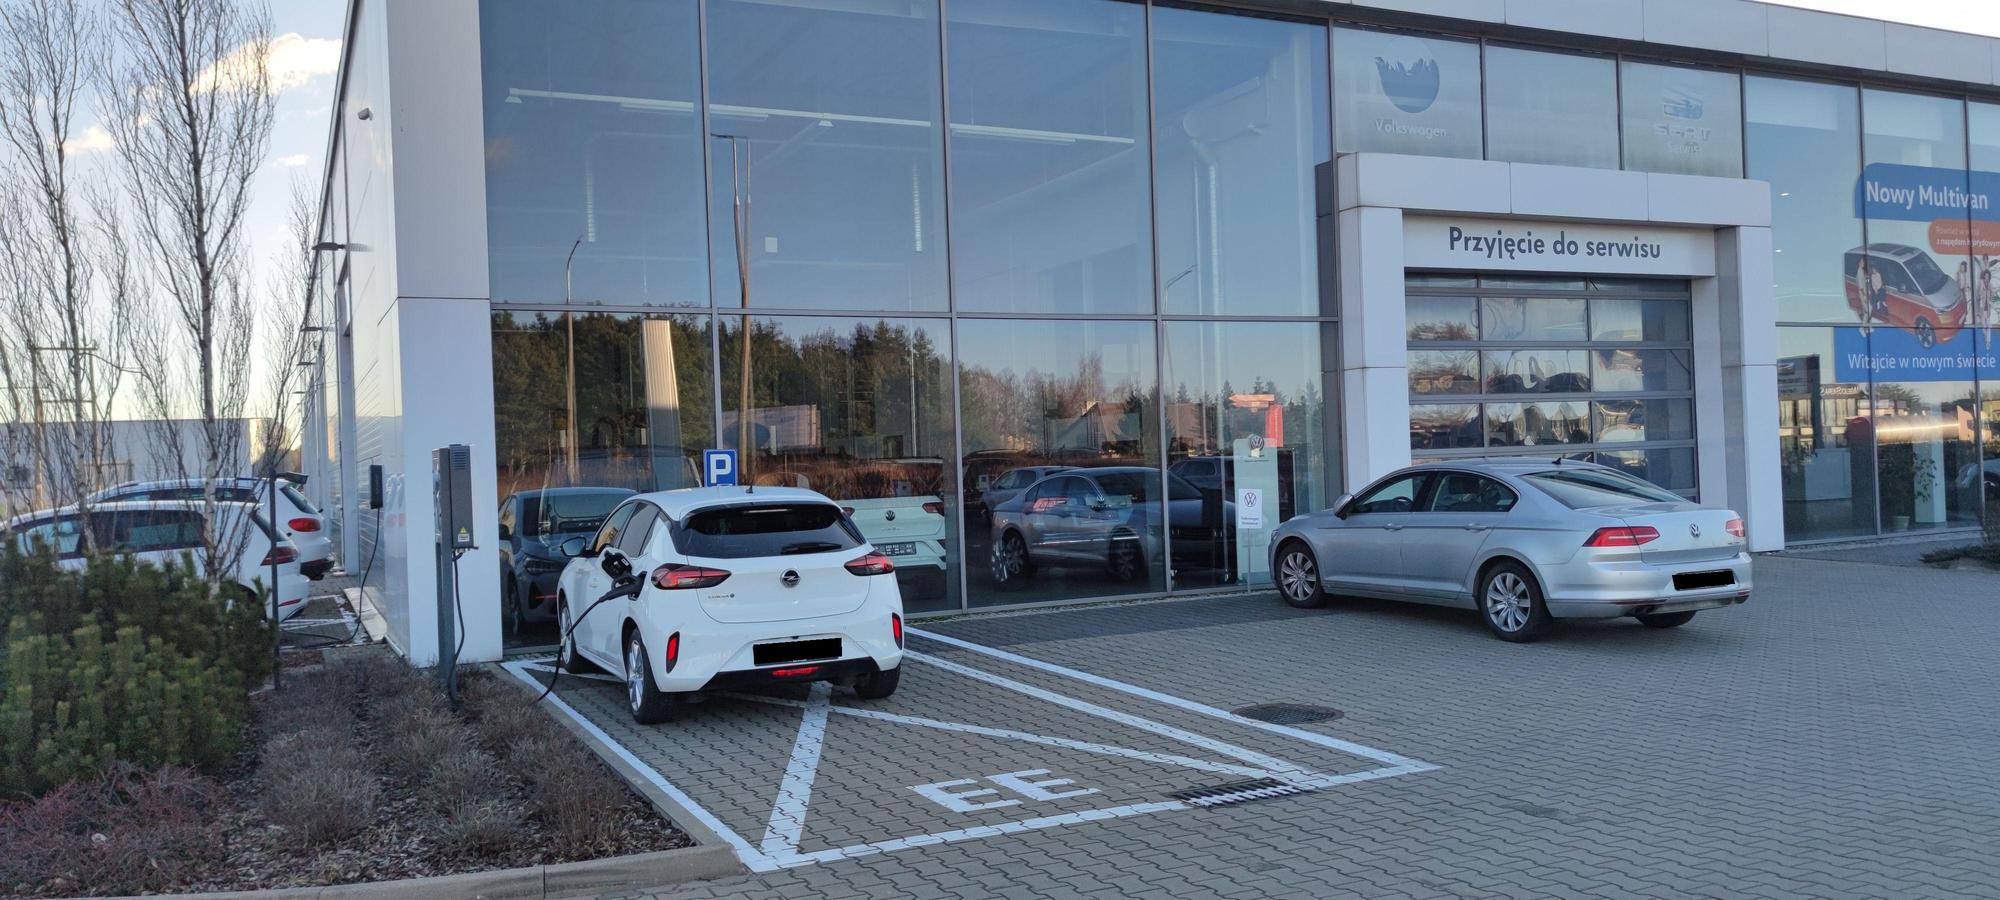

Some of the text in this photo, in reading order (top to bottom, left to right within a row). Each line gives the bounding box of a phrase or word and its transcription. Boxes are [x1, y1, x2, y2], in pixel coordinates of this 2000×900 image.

[1375, 119, 1448, 140] Volkswagen
[1866, 181, 1988, 210] Nowy Multivan
[1449, 226, 1661, 260] Przyjęcie do serwisu
[1848, 353, 1996, 373] Witajcie w nowym świecie
[710, 453, 732, 484] P
[905, 768, 1101, 812] EE
